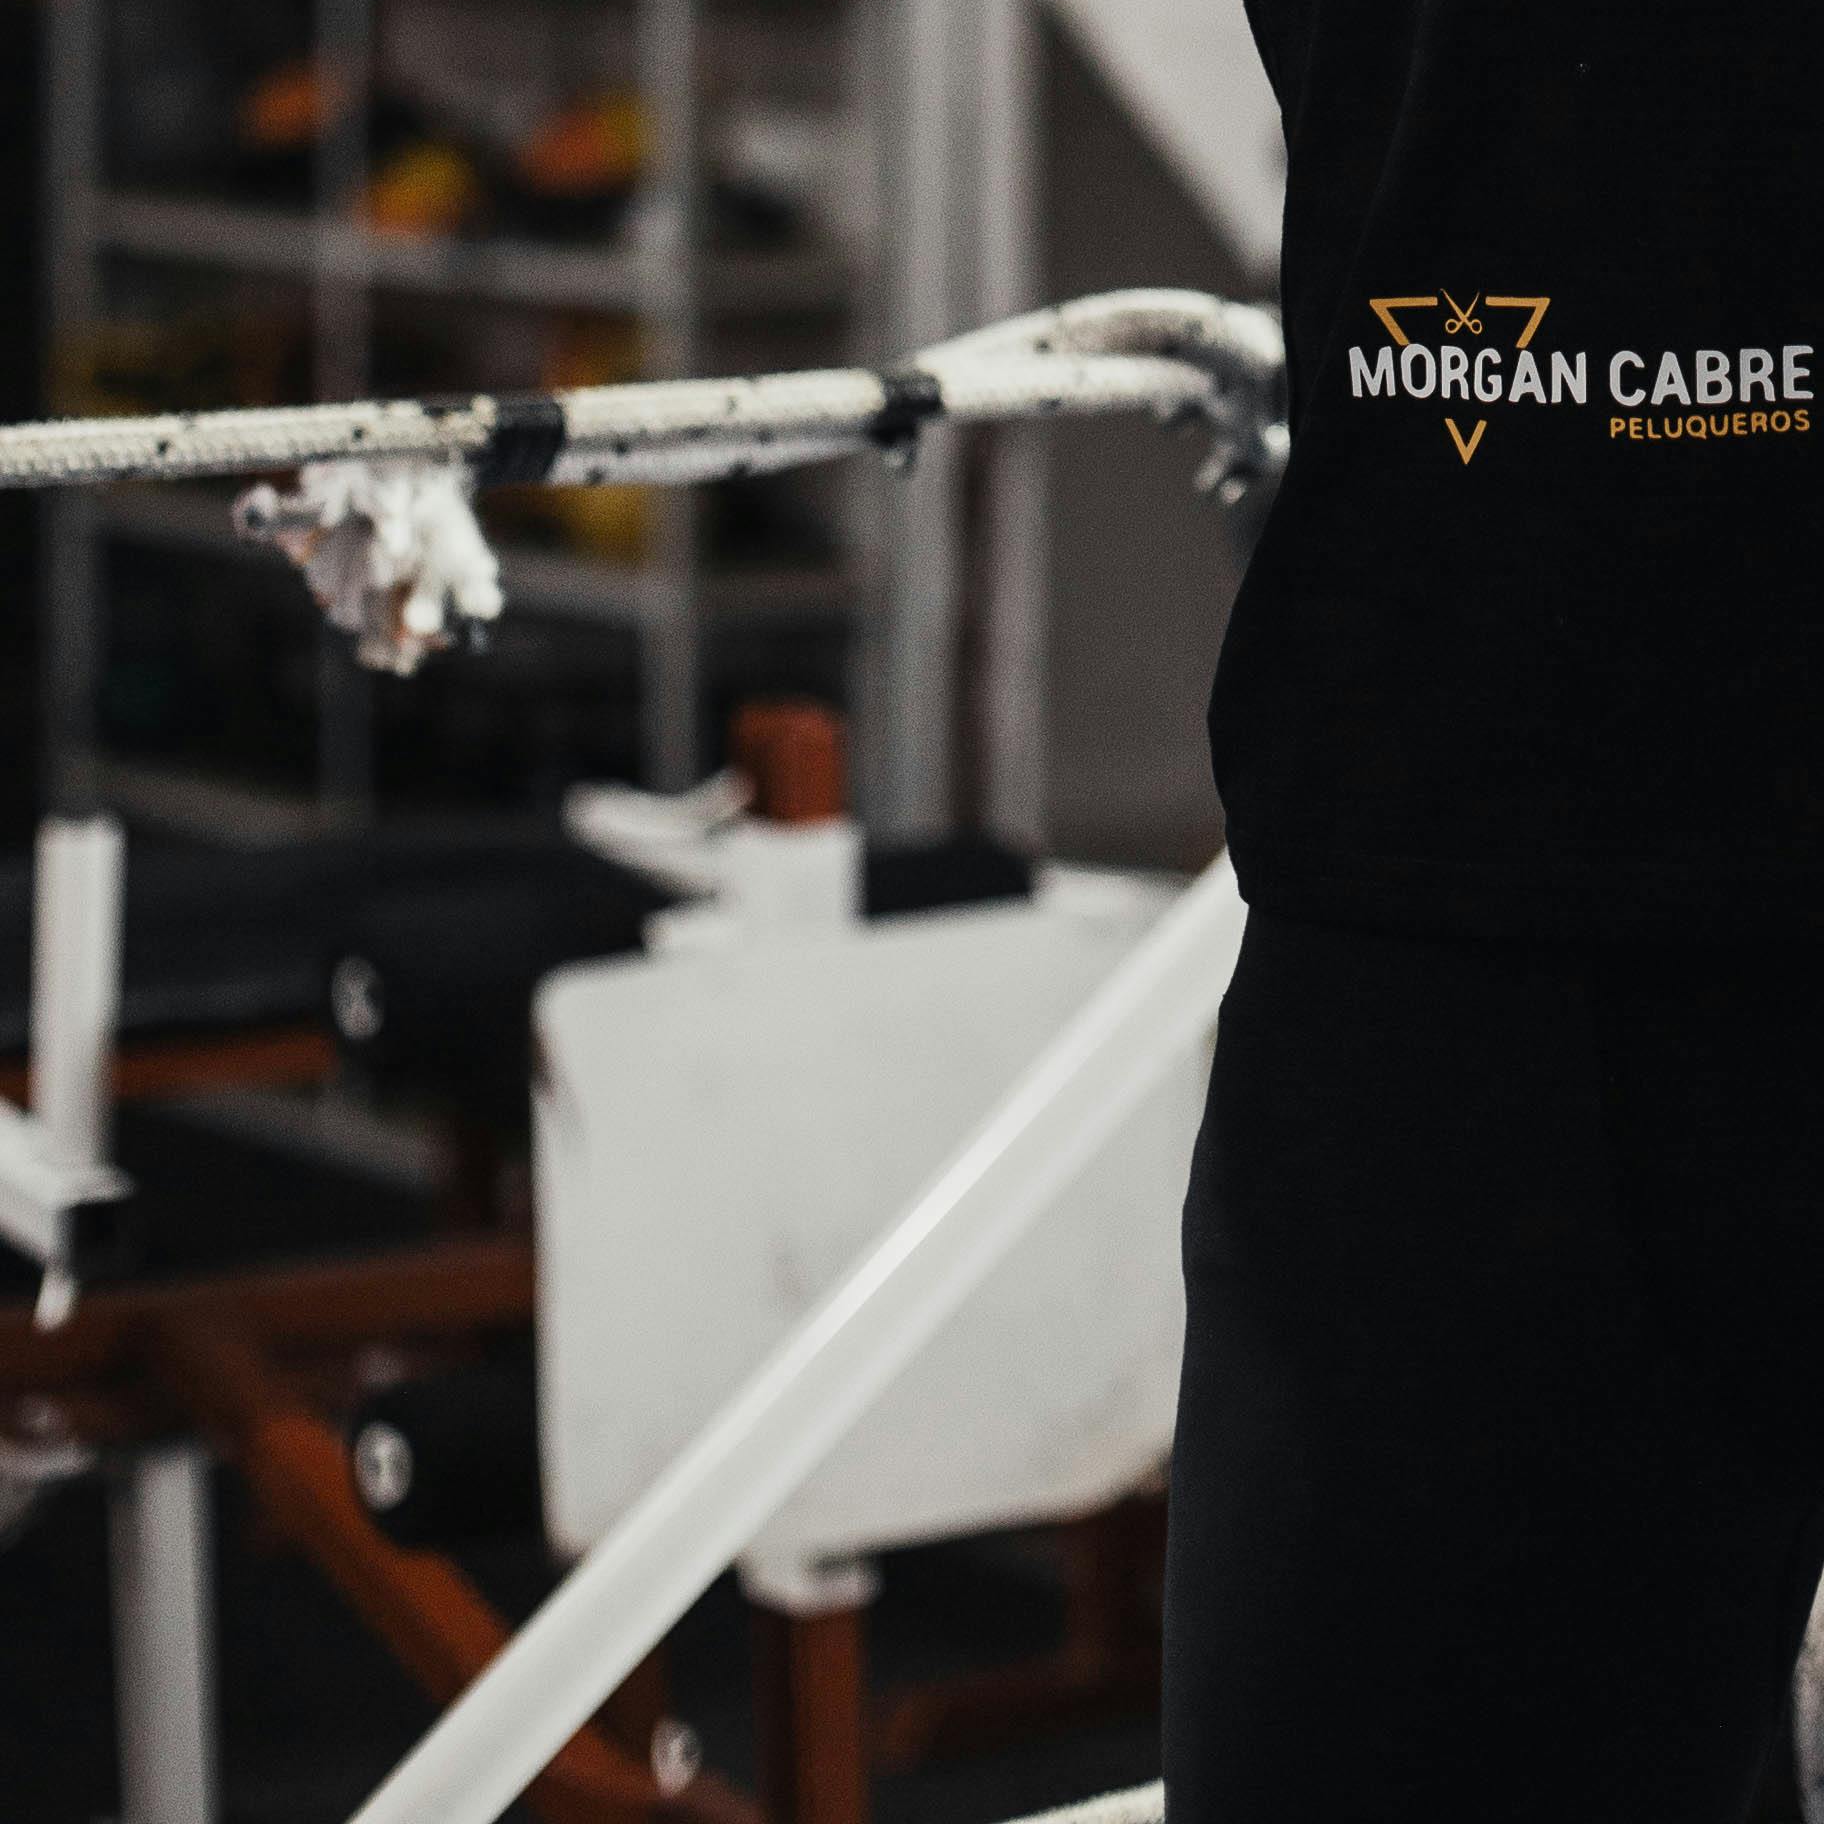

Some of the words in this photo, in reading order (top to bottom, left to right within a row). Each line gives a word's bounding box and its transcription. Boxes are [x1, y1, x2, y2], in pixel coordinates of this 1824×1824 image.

[1348, 343, 1588, 405] MORGAN
[1608, 344, 1815, 407] CABRE
[1610, 408, 1811, 441] PELUQUEROS
